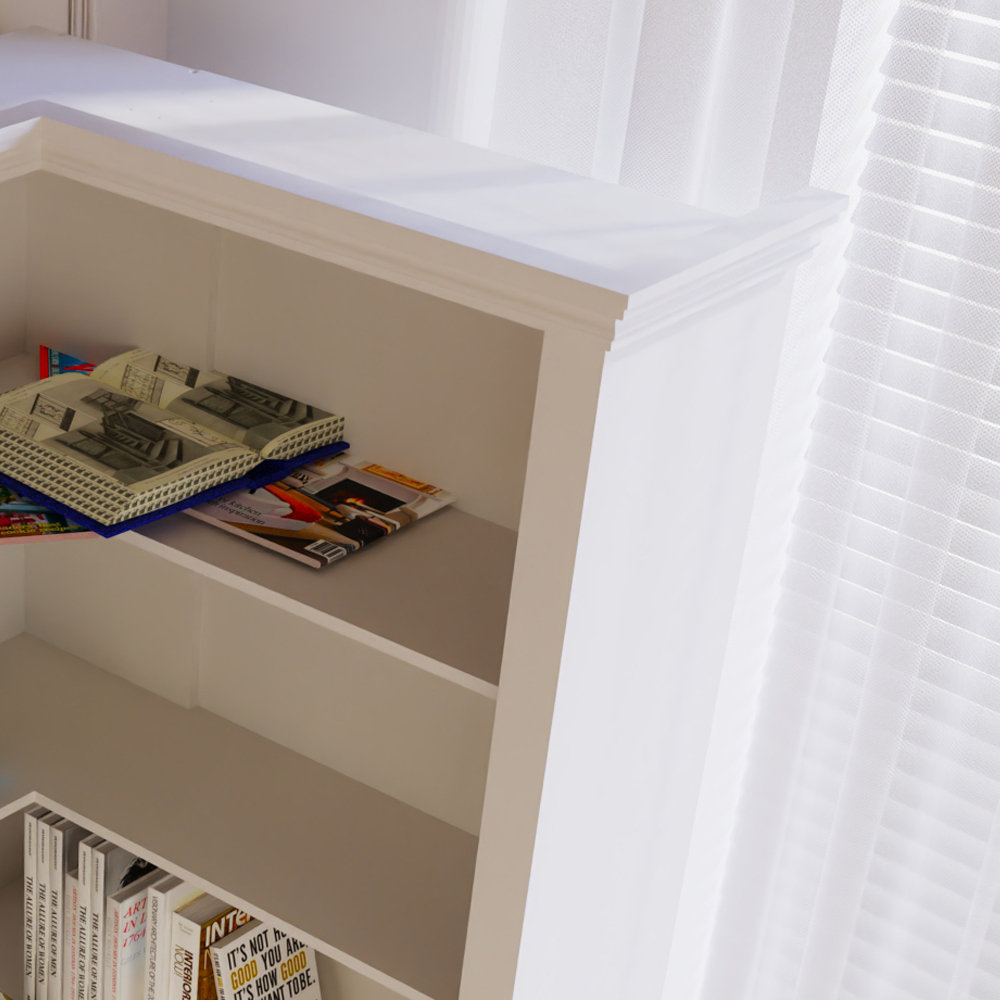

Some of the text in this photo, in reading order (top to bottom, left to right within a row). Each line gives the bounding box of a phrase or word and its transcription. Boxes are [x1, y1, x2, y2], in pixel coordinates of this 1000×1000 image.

[26, 874, 34, 896] THE
[51, 888, 59, 909] THE
[26, 895, 34, 931] ALLURE
[26, 929, 33, 944] OF
[51, 943, 58, 957] OF
[227, 944, 248, 970] IT'S
[249, 929, 269, 958] NOT
[50, 956, 58, 979] MEN
[230, 944, 282, 991] GOOD YOU
[256, 968, 278, 996] HOW
[280, 950, 308, 982] GOOD
